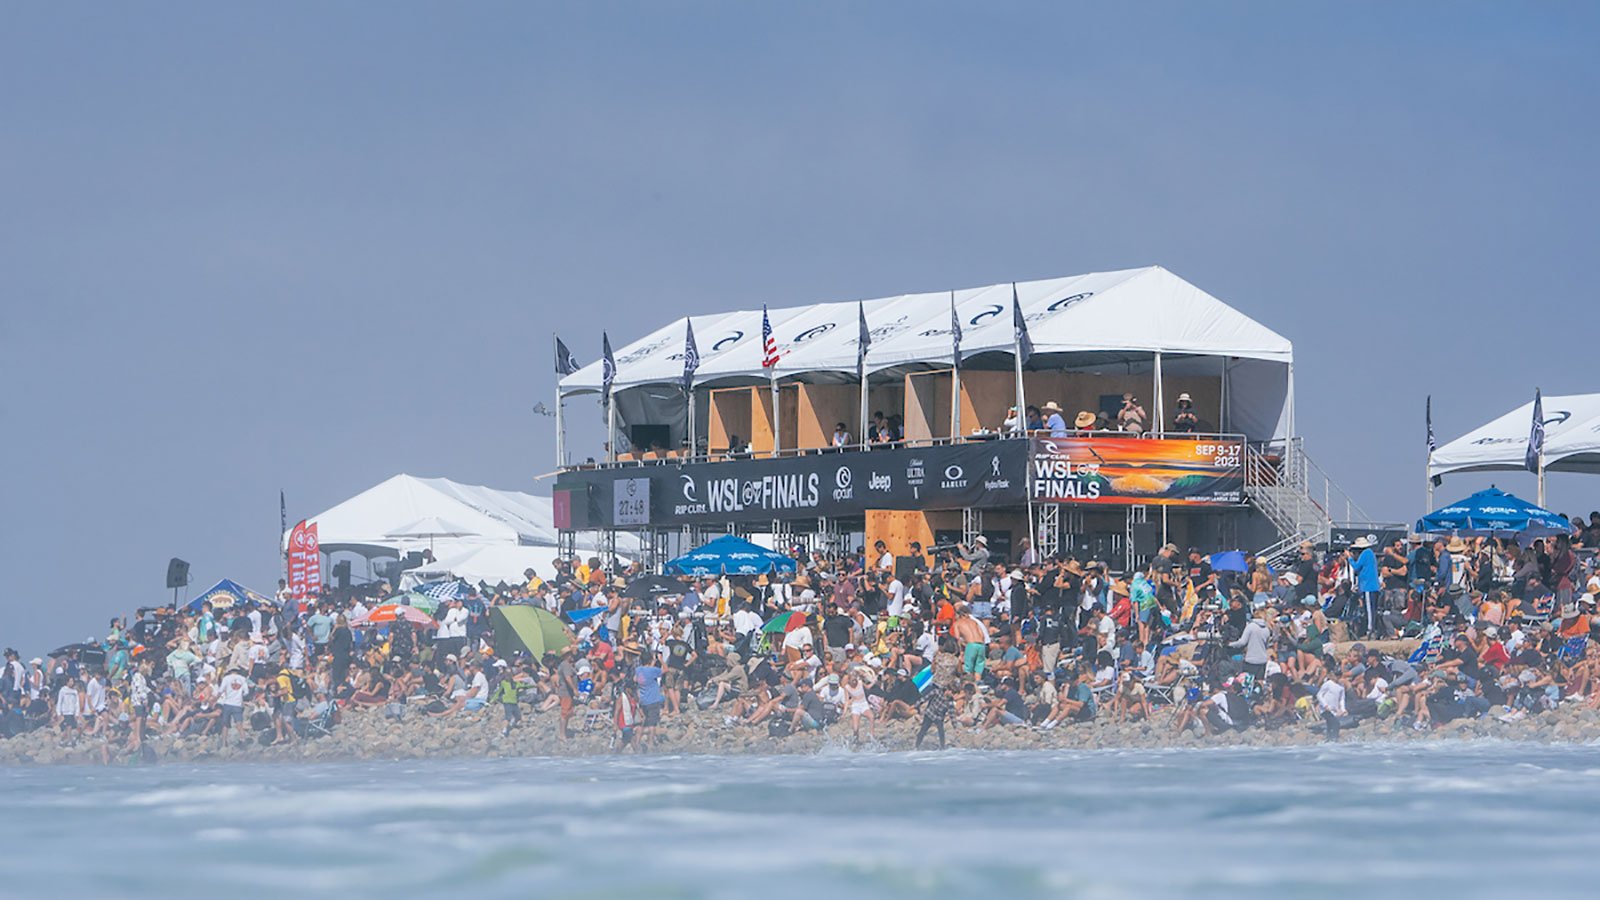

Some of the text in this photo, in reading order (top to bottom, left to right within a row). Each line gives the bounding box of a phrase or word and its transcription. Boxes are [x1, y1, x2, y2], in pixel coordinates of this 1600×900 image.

[1195, 445, 1240, 456] SEP 9-17
[1214, 456, 1241, 467] 2021
[1034, 460, 1077, 479] WSL
[868, 472, 891, 492] Jeep
[941, 480, 967, 489] OAKLEY
[1034, 480, 1100, 499] FINALS
[707, 472, 819, 512] WSL FINALS
[619, 500, 644, 515] 27:48
[674, 503, 708, 515] RIP CURL
